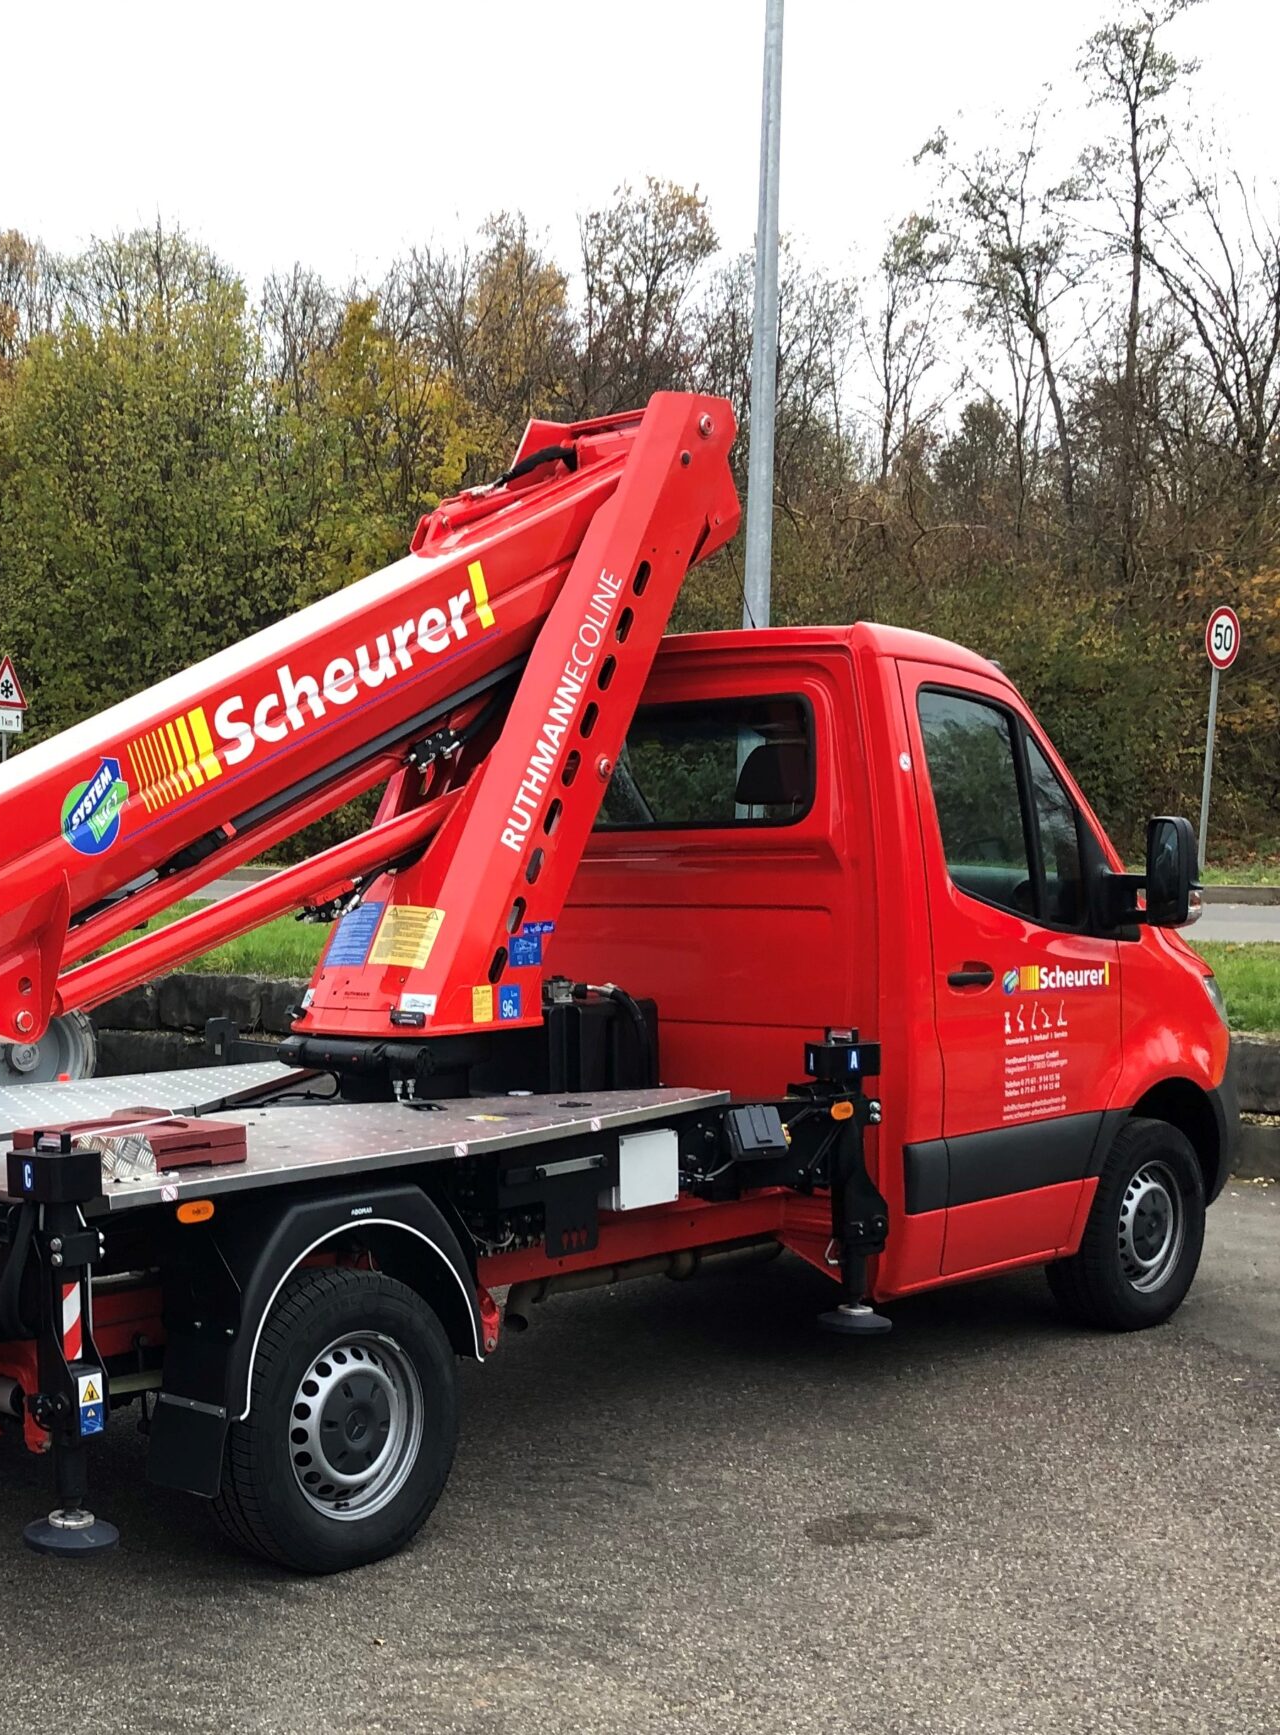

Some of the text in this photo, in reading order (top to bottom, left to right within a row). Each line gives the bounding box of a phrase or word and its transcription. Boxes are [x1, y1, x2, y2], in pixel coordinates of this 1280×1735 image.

[1214, 623, 1233, 651] 50
[214, 588, 471, 767] Scheurer
[5, 717, 13, 726] km
[71, 765, 113, 832] SYSTEM
[95, 790, 118, 827] LIFT
[1040, 965, 1105, 989] Scheurer
[502, 999, 514, 1018] 96
[850, 1050, 858, 1069] A
[24, 1164, 31, 1188] C
